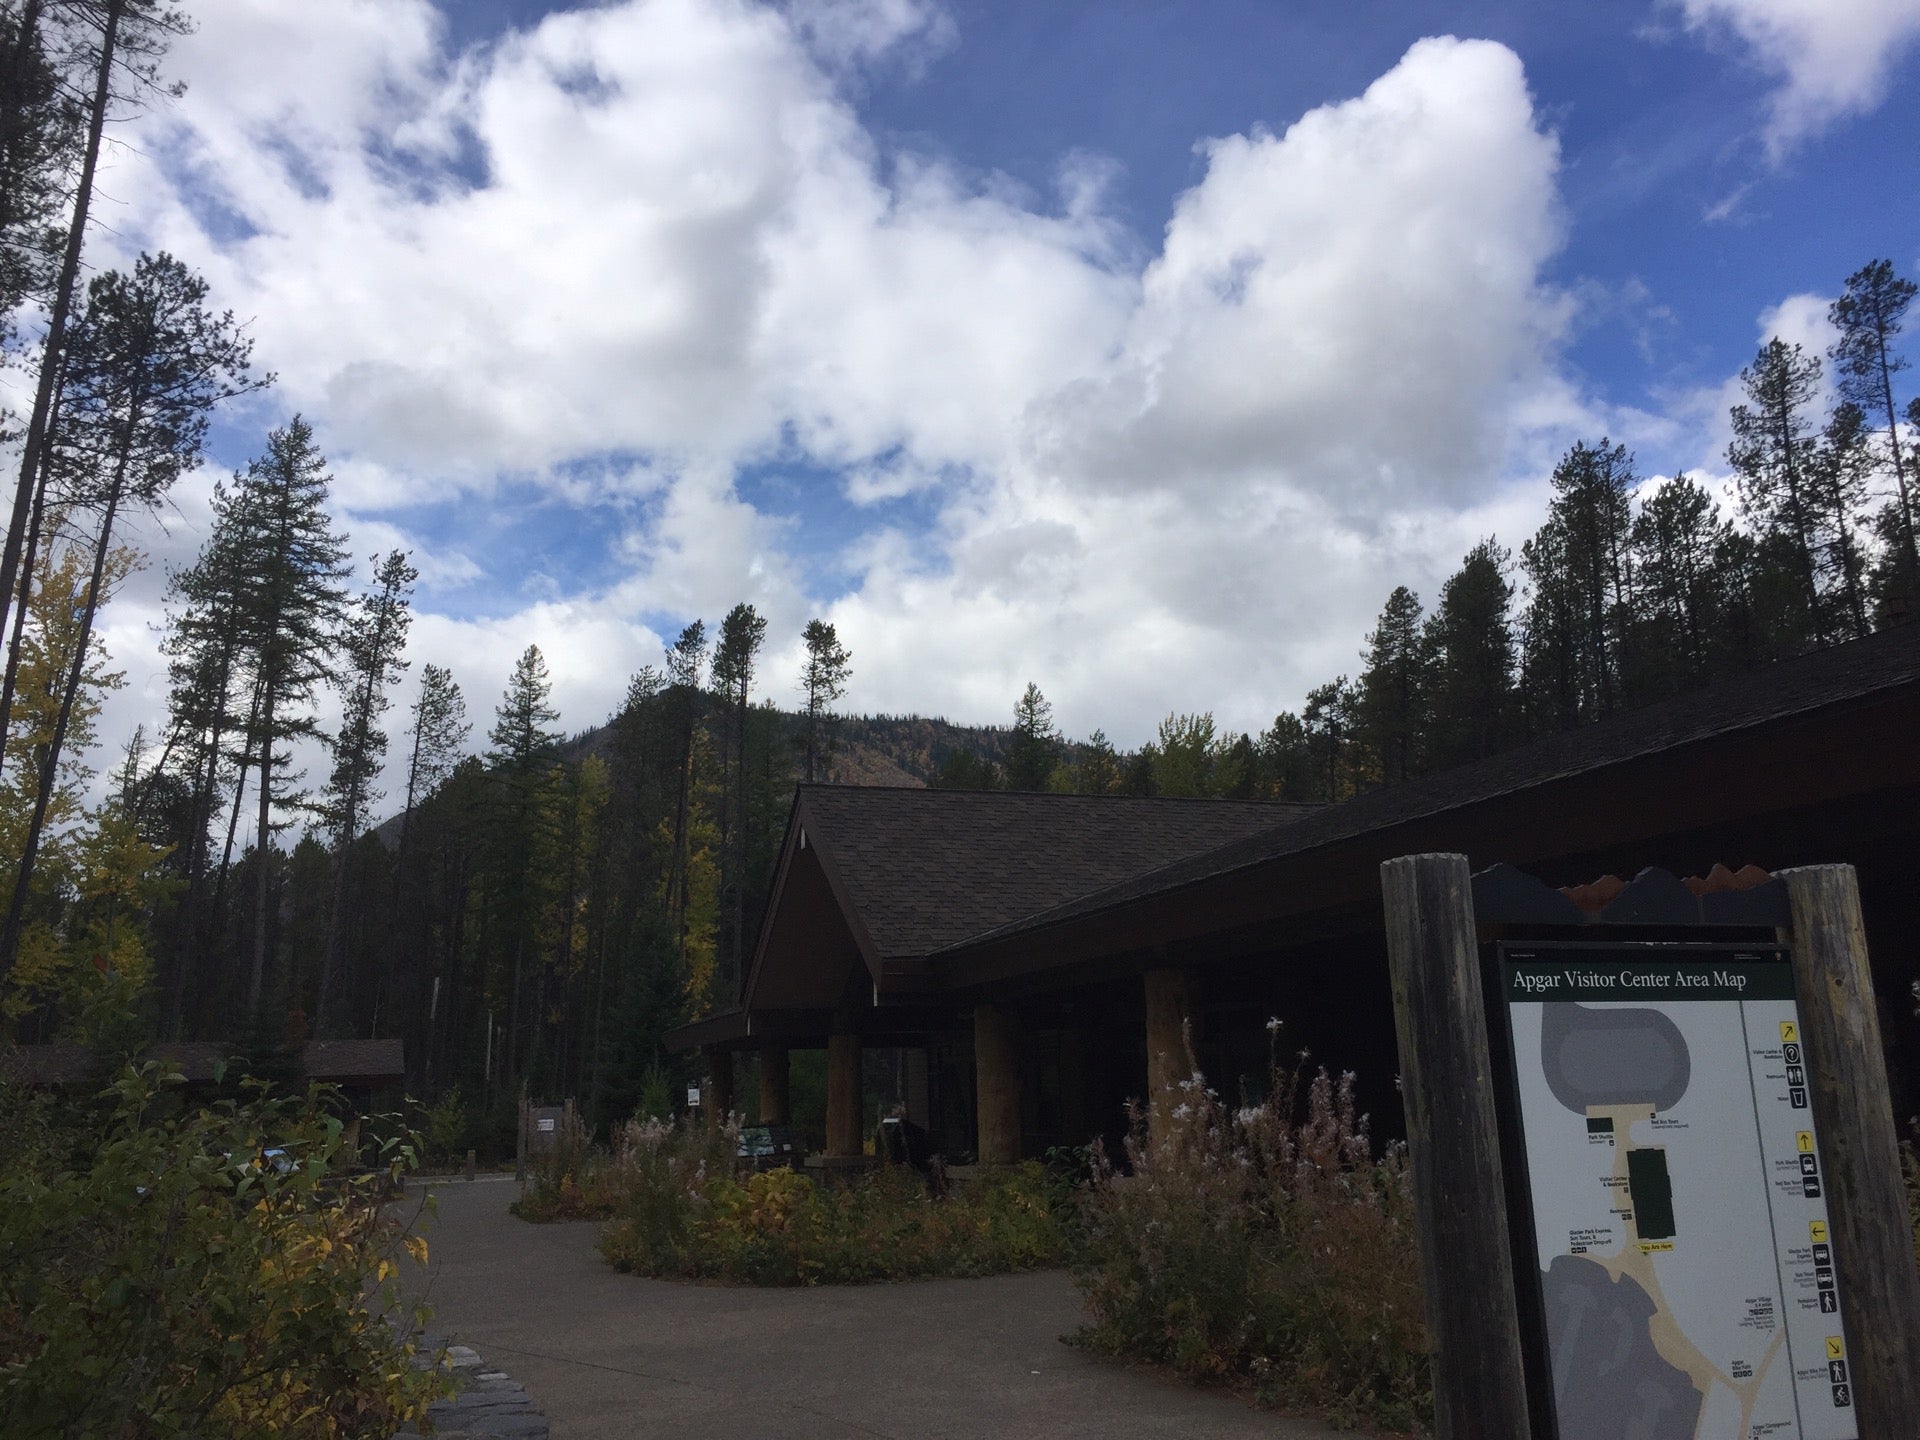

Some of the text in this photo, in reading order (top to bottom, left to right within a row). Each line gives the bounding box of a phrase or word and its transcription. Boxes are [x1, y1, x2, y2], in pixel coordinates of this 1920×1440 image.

[1513, 970, 1746, 992] Apgar Visitor Center Area Map
